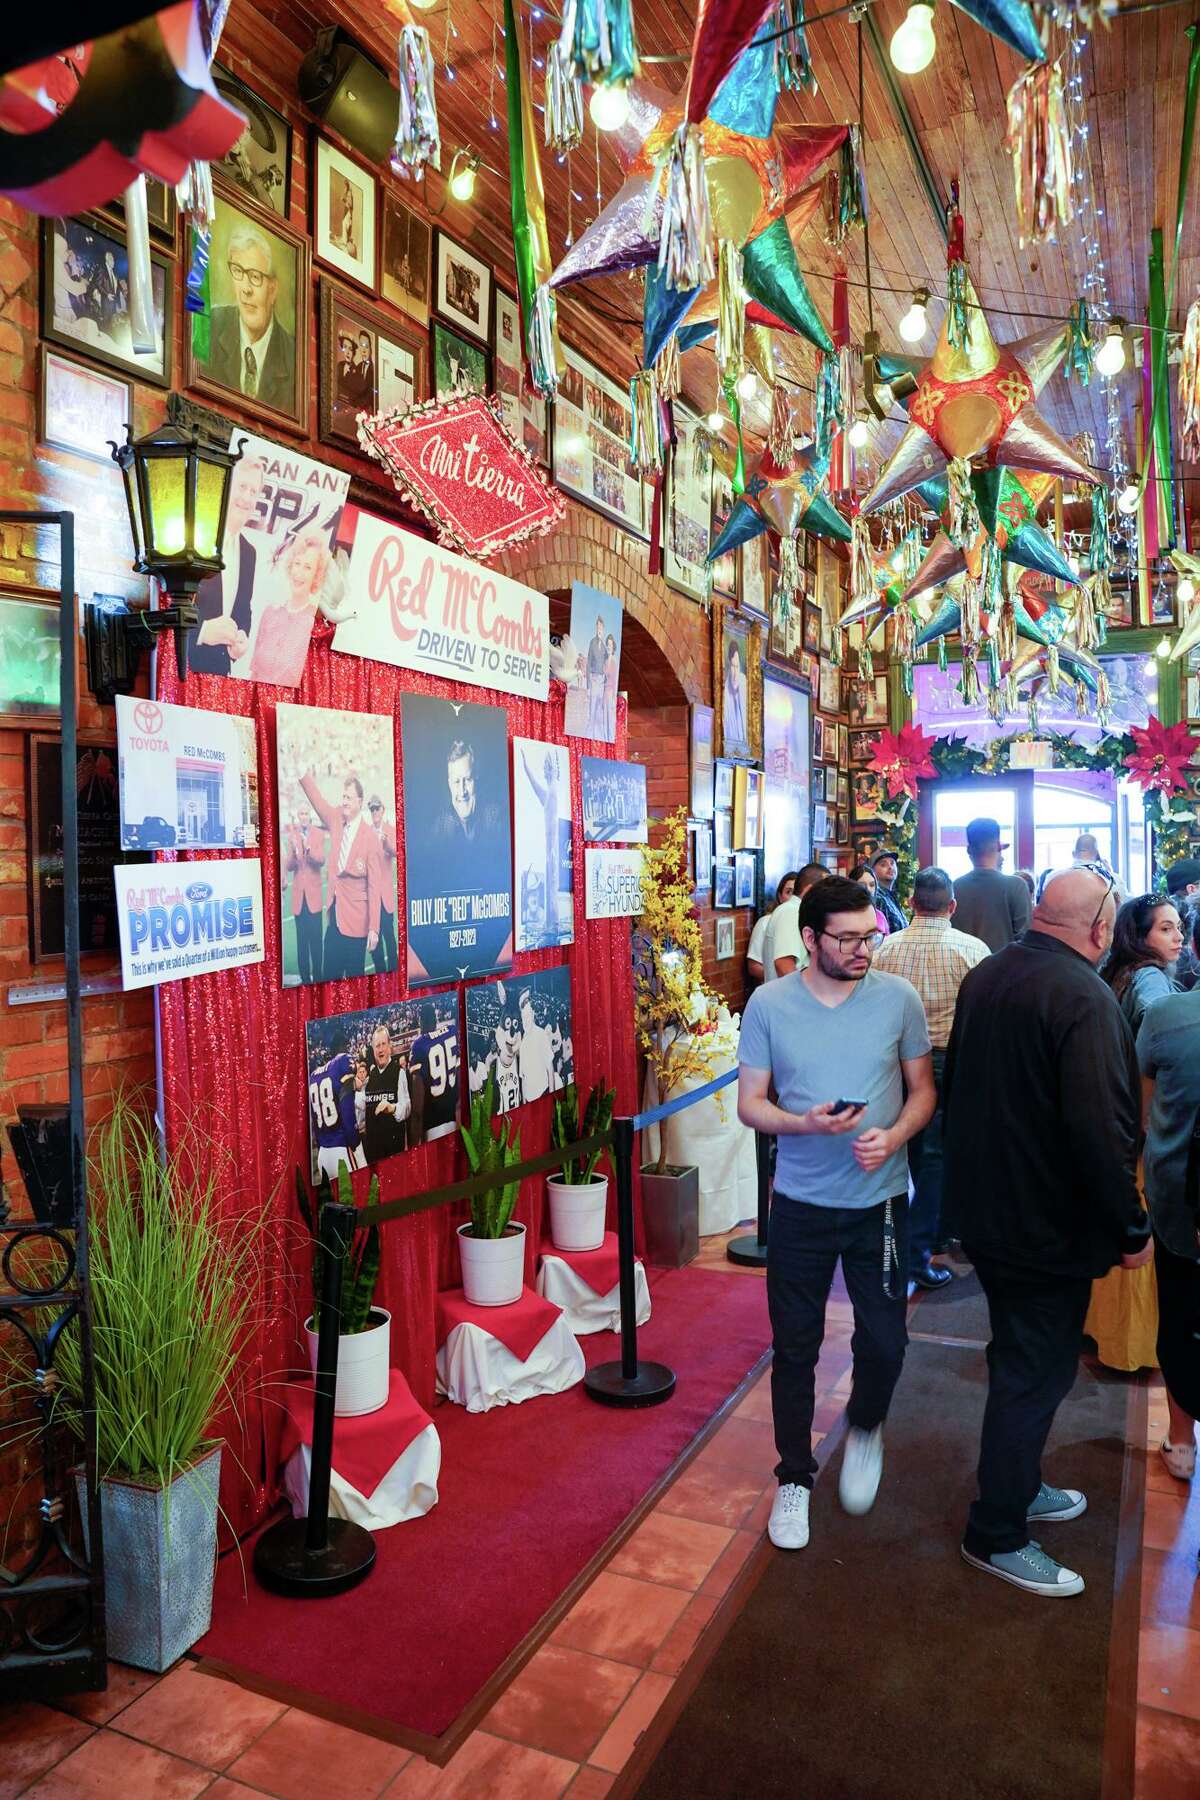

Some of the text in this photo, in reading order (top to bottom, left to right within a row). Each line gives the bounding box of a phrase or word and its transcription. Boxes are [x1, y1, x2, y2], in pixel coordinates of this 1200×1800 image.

[368, 535, 435, 642] Red
[417, 628, 543, 684] DRIVEN TO SERVE
[129, 735, 170, 753] TOYOTA
[183, 744, 196, 757] RED
[190, 886, 209, 900] Ford
[411, 892, 510, 927] BILLY JOE "RED" McCOMBS
[128, 895, 255, 956] PROMISE
[449, 928, 477, 949] 1927-2023
[428, 1035, 461, 1097] 95
[883, 1234, 892, 1272] SAMSUNG
